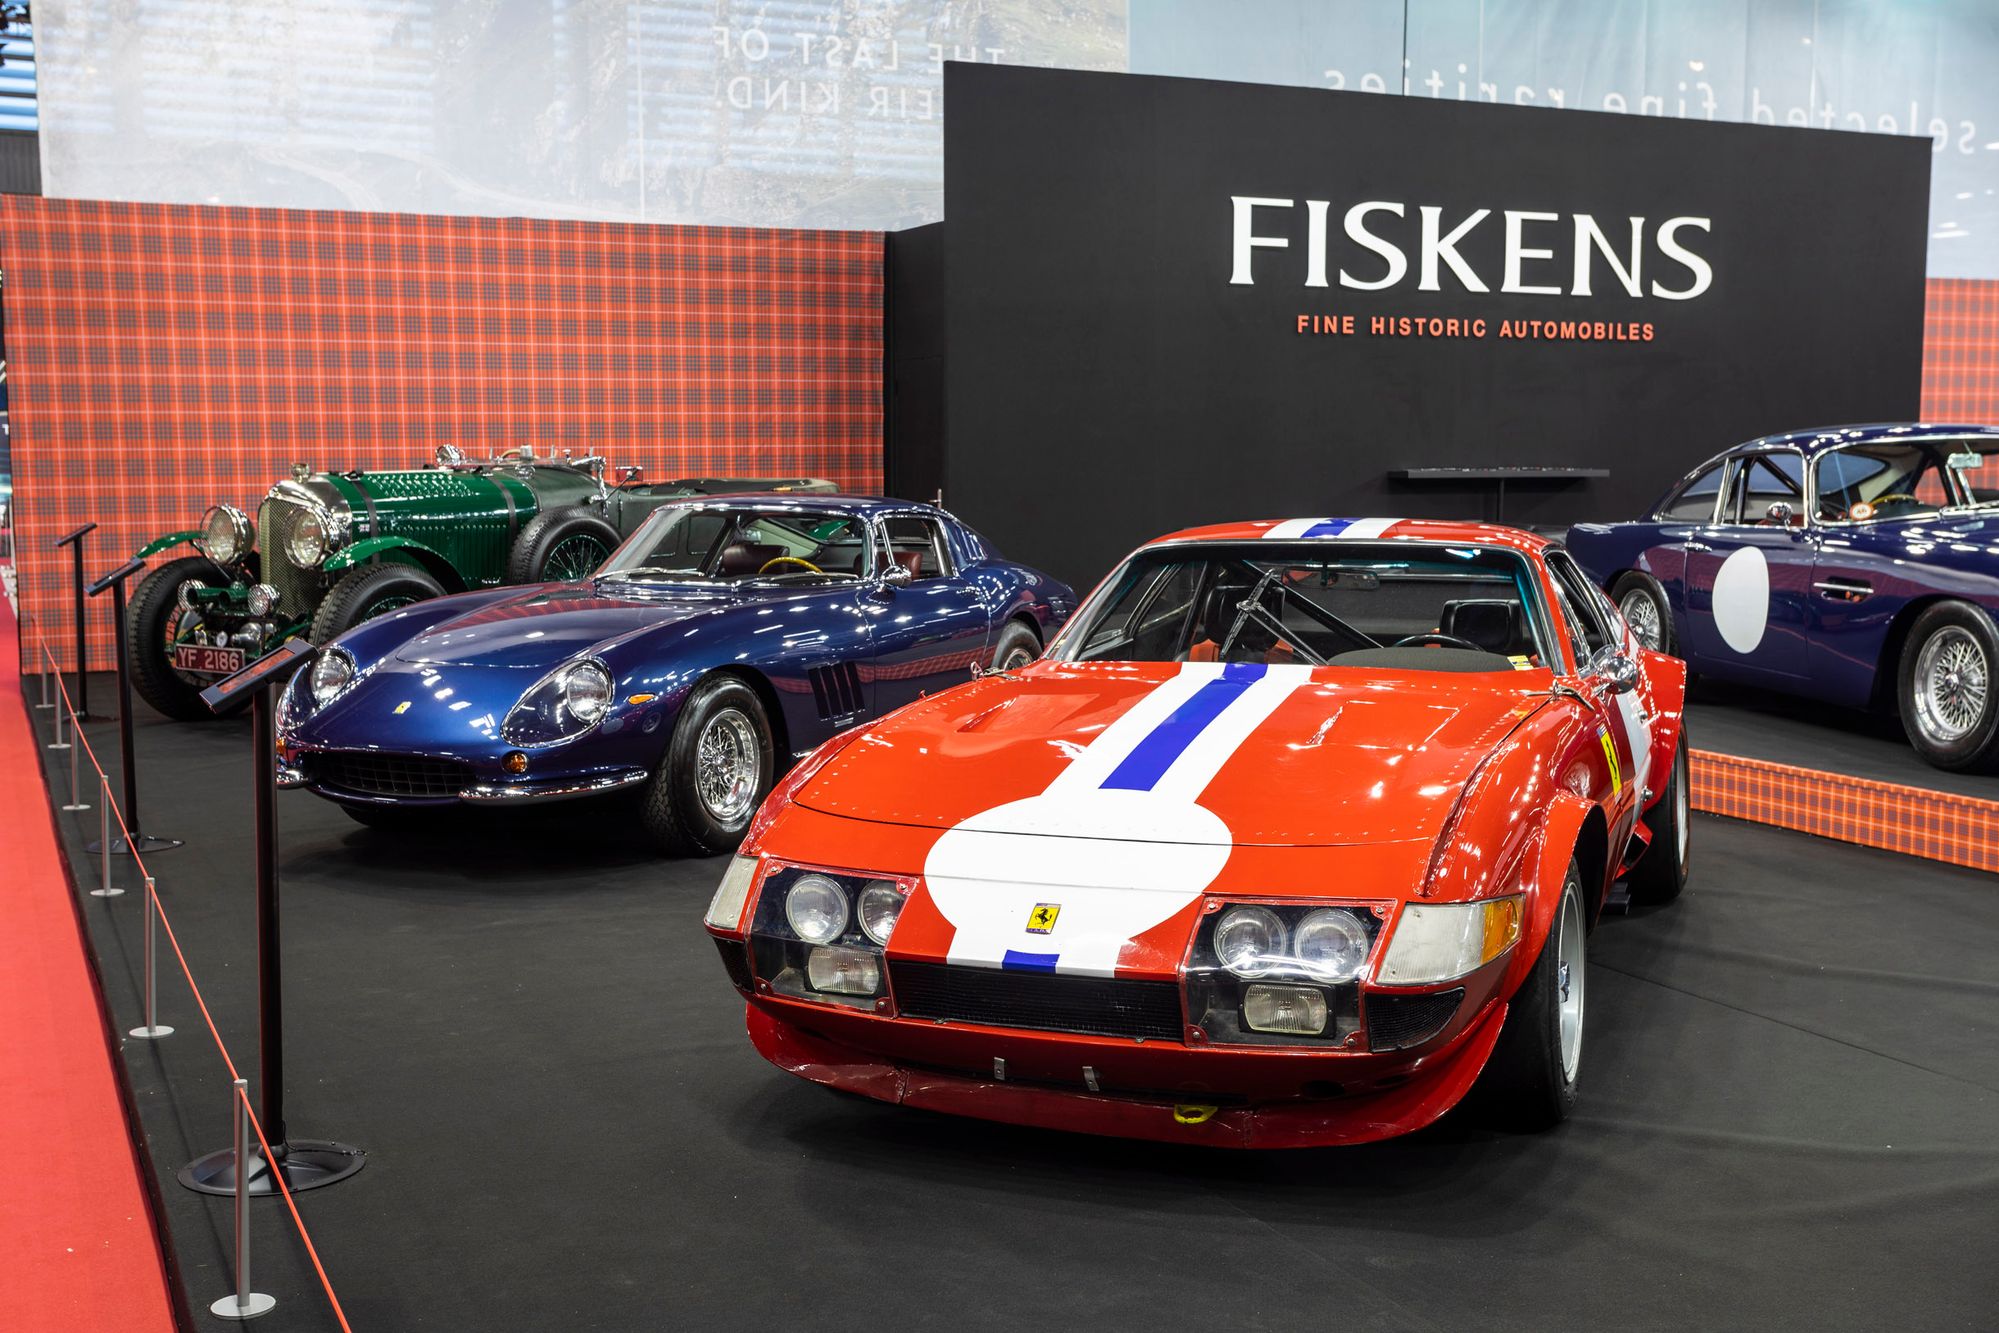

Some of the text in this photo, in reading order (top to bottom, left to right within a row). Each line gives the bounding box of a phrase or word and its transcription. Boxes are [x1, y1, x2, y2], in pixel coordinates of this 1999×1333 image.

[1229, 196, 1713, 300] FISKENS
[1297, 315, 1654, 341] FINE HISTORIC AUTOMOBILES
[178, 647, 239, 671] YF 2186
